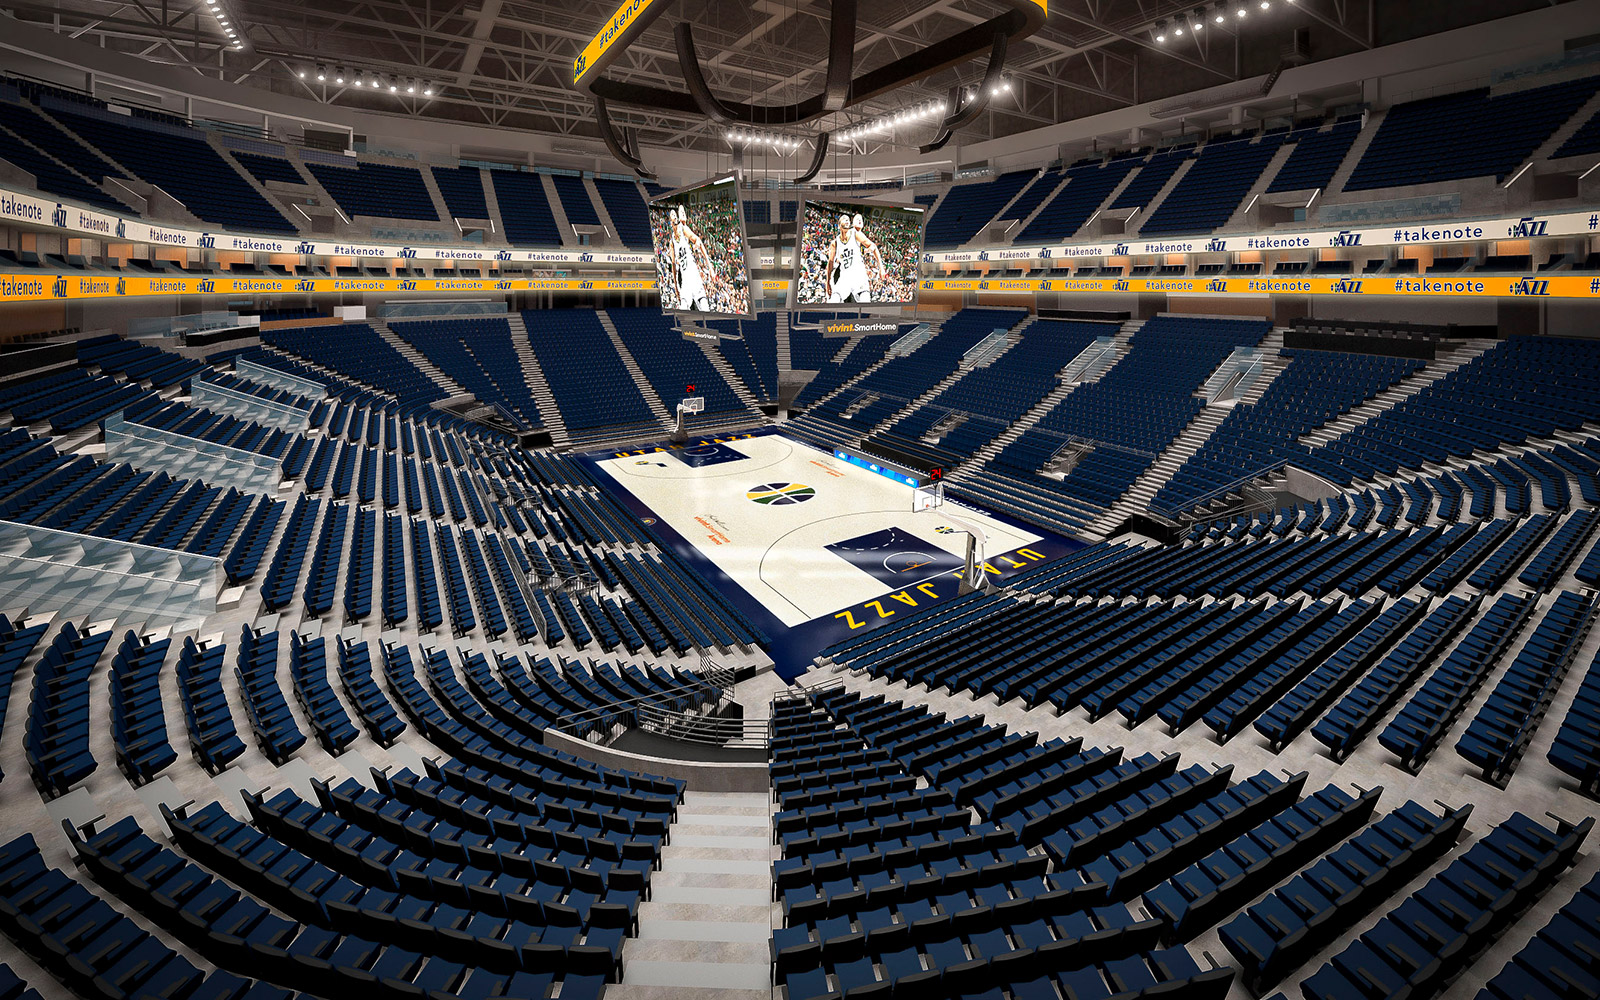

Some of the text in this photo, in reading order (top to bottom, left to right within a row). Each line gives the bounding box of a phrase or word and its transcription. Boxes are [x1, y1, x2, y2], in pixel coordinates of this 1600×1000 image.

[599, 0, 645, 49] #takeno
[0, 195, 42, 220] takenote
[80, 211, 109, 232] #takenote
[150, 228, 186, 244] #takenote
[233, 238, 282, 251] #takenote
[334, 245, 384, 257] #takenote
[435, 250, 483, 260] #takenote
[528, 252, 568, 262] #takenote
[607, 254, 643, 263] #takenote
[945, 253, 971, 261] #takenote
[1000, 250, 1030, 260] #takenote
[1065, 247, 1102, 257] #takenote
[1145, 242, 1192, 254] #takenote
[1248, 236, 1310, 248] #takenote
[1394, 226, 1483, 242] #takenote
[0, 276, 42, 296] takenote
[80, 278, 109, 294] #takenote
[150, 280, 186, 293] #takenote
[233, 280, 282, 291] #takenote
[334, 280, 385, 291] #takenote
[435, 280, 483, 290] #takenote
[528, 281, 569, 289] #takenote
[607, 281, 643, 289] #takenote
[945, 281, 971, 289] #takenote
[1000, 281, 1030, 289] #takenote
[1065, 281, 1103, 290] #takenote
[1145, 280, 1193, 291] #takenote
[1248, 280, 1311, 291] #takenote
[1395, 279, 1484, 292] #takenote
[615, 433, 757, 459] UTAH JAZZ
[931, 468, 942, 480] 24
[834, 582, 940, 630] JAZZ
